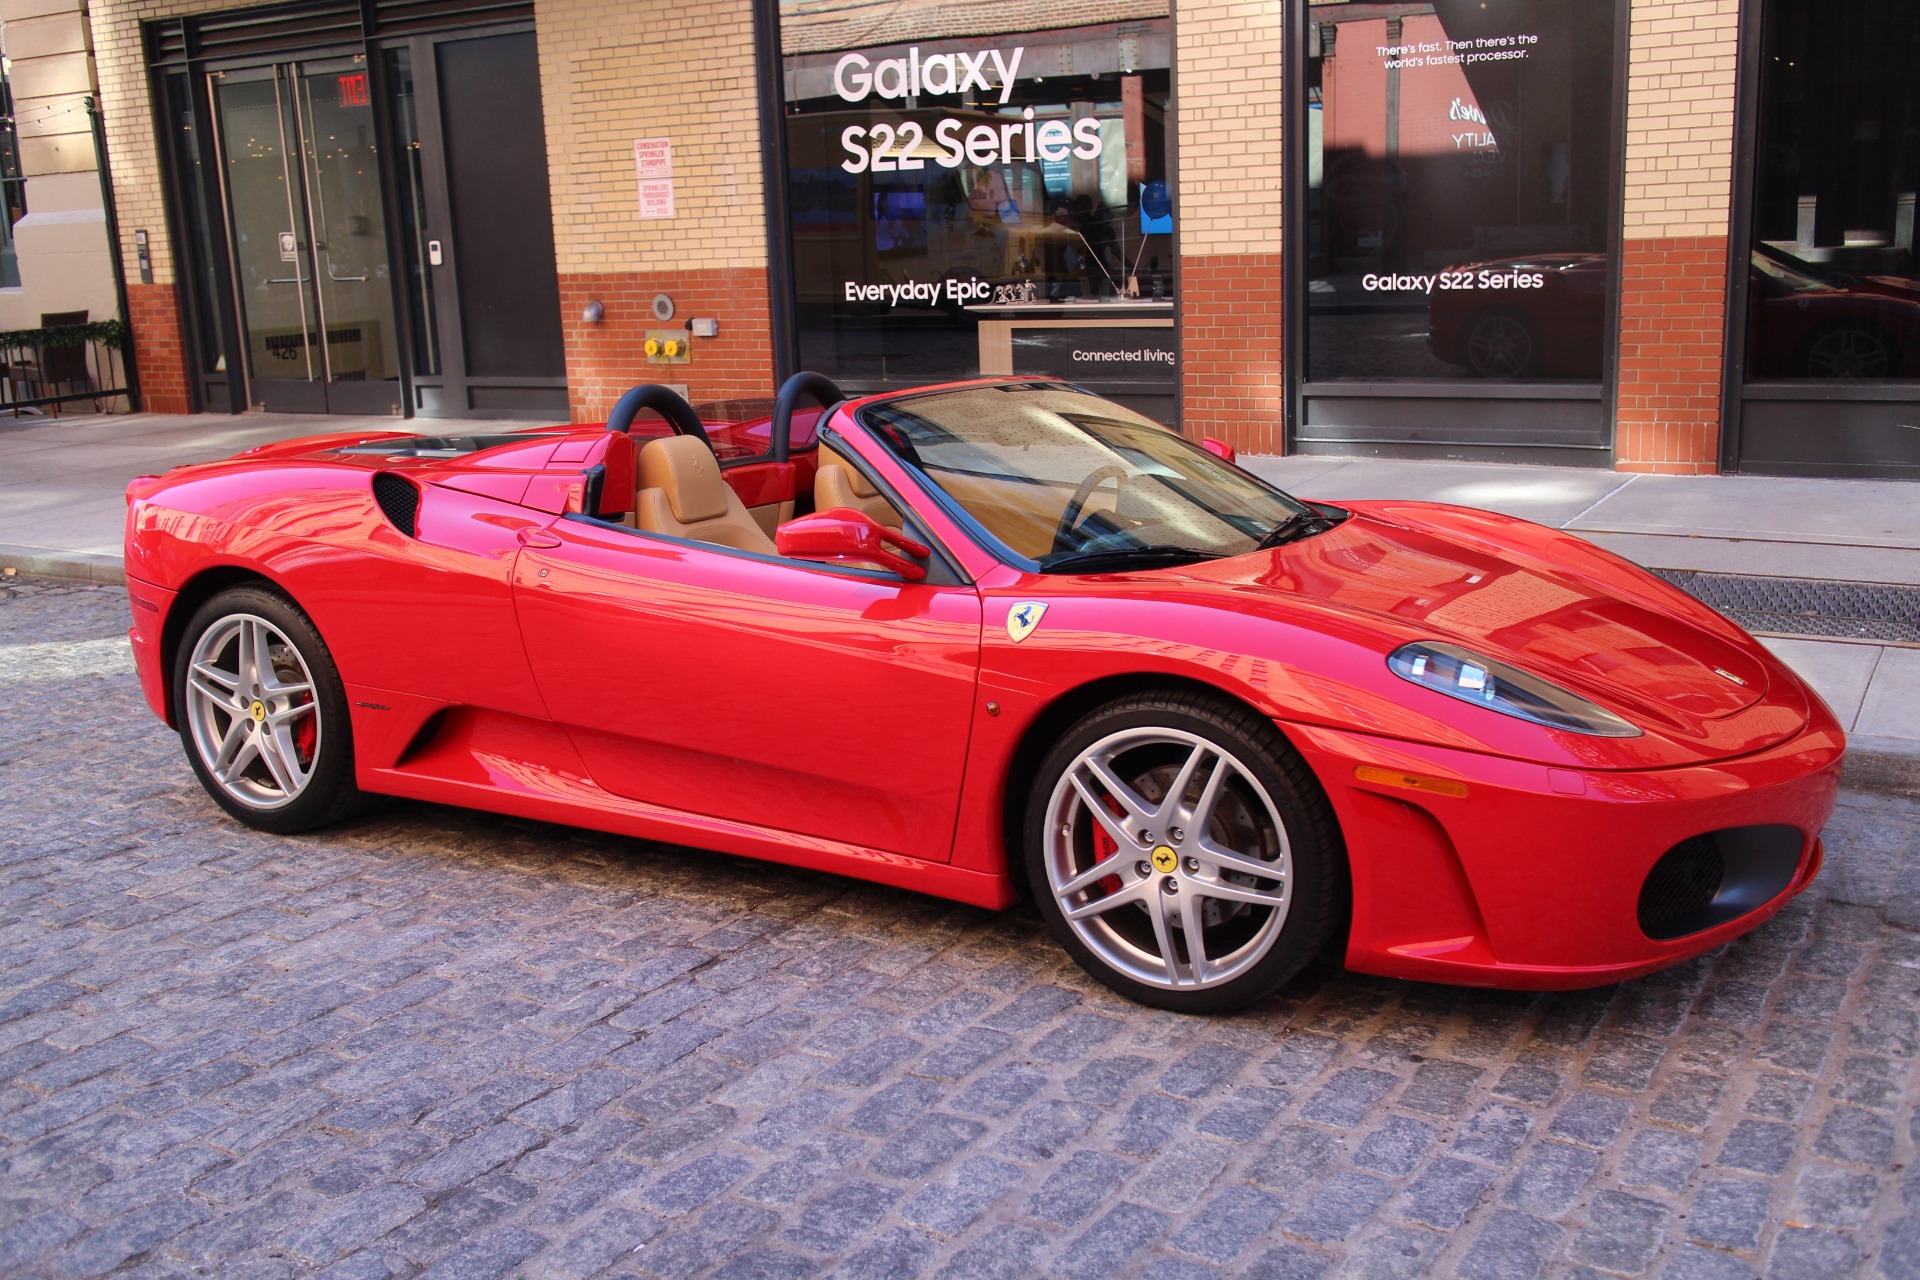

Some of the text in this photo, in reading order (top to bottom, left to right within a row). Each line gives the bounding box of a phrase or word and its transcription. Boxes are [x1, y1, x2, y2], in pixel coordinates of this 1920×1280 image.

[1376, 34, 1538, 57] There's fast. Then there's the
[1383, 49, 1529, 69] world's fastest processor.
[833, 46, 1024, 104] Galaxy
[636, 141, 668, 150] COMBINATION
[841, 107, 1103, 174] S22 Series
[641, 159, 667, 167] STANDPIPE
[845, 276, 990, 307] Everyday Epic
[1362, 270, 1544, 295] Galaxy S22 Series
[1072, 349, 1175, 365] Connected living
